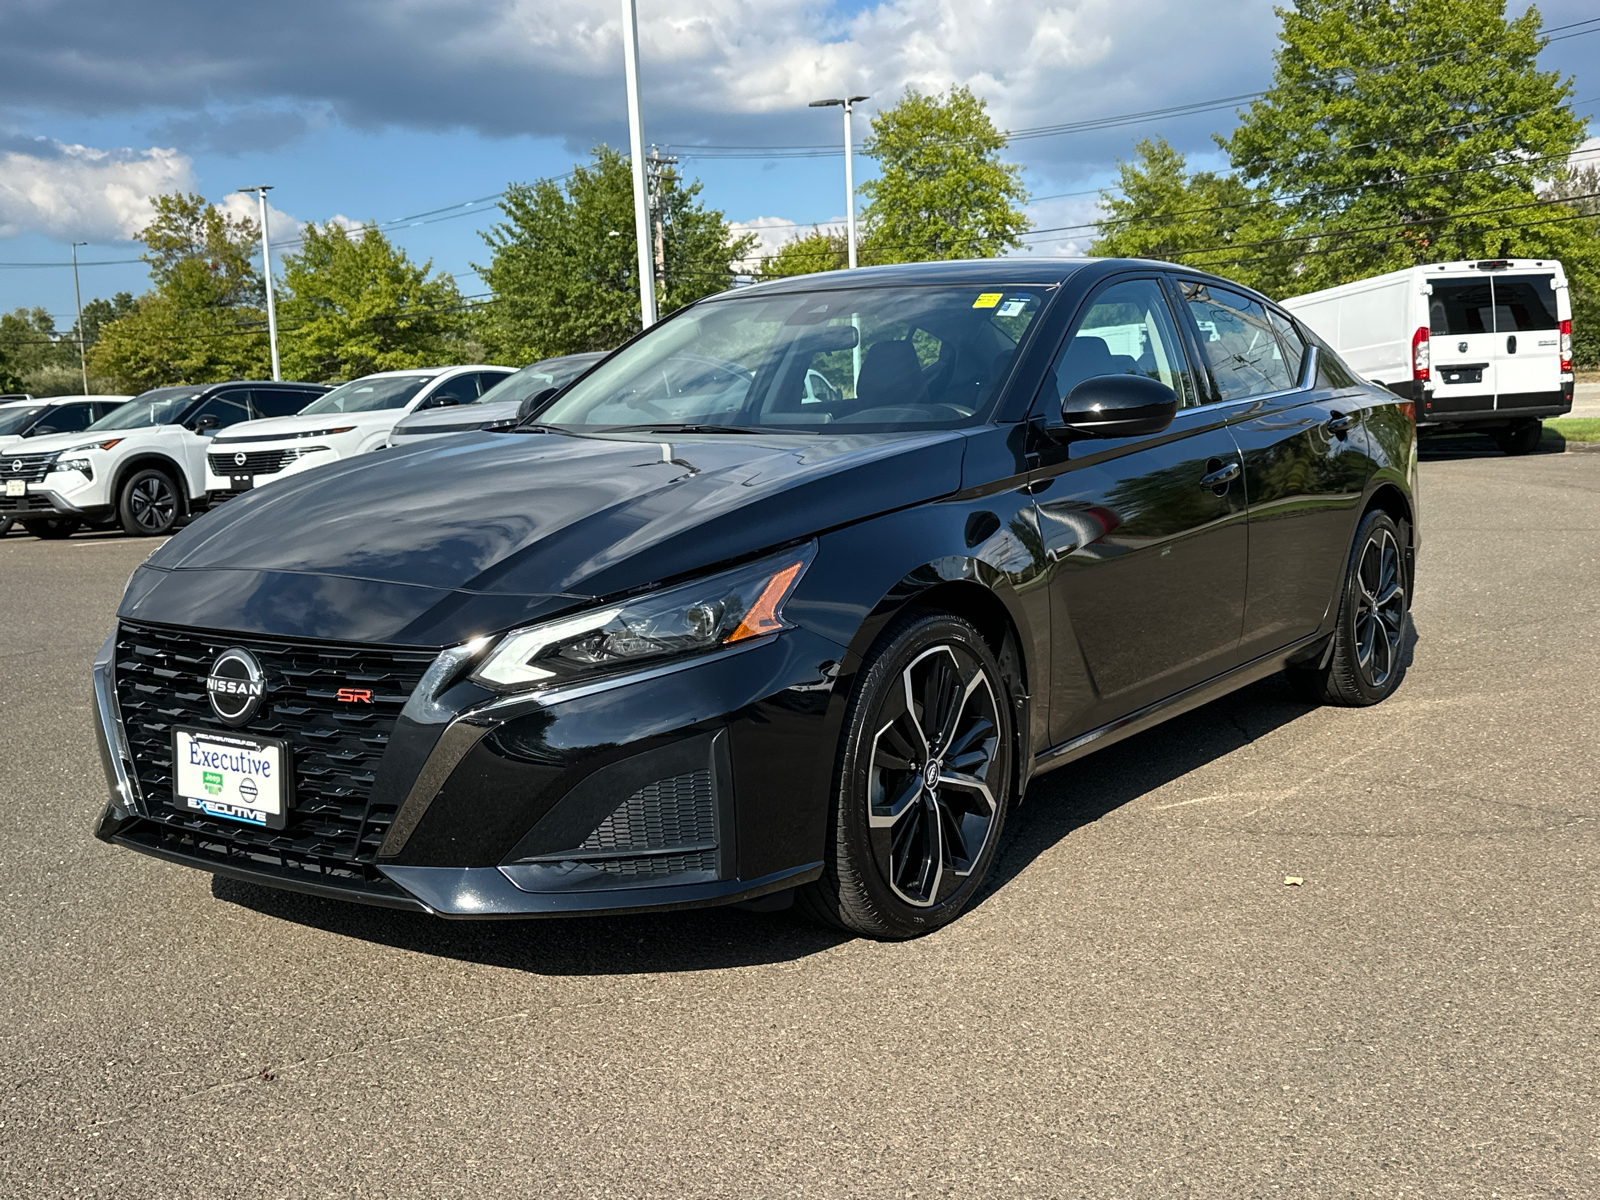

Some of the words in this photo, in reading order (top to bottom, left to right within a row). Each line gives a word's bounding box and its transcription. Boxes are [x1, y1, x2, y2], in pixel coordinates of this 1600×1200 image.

[206, 677, 261, 695] NISSAN
[337, 688, 371, 703] SR
[189, 741, 271, 778] Executive
[205, 772, 221, 784] Jeep
[187, 797, 267, 822] EXECUTIVE
